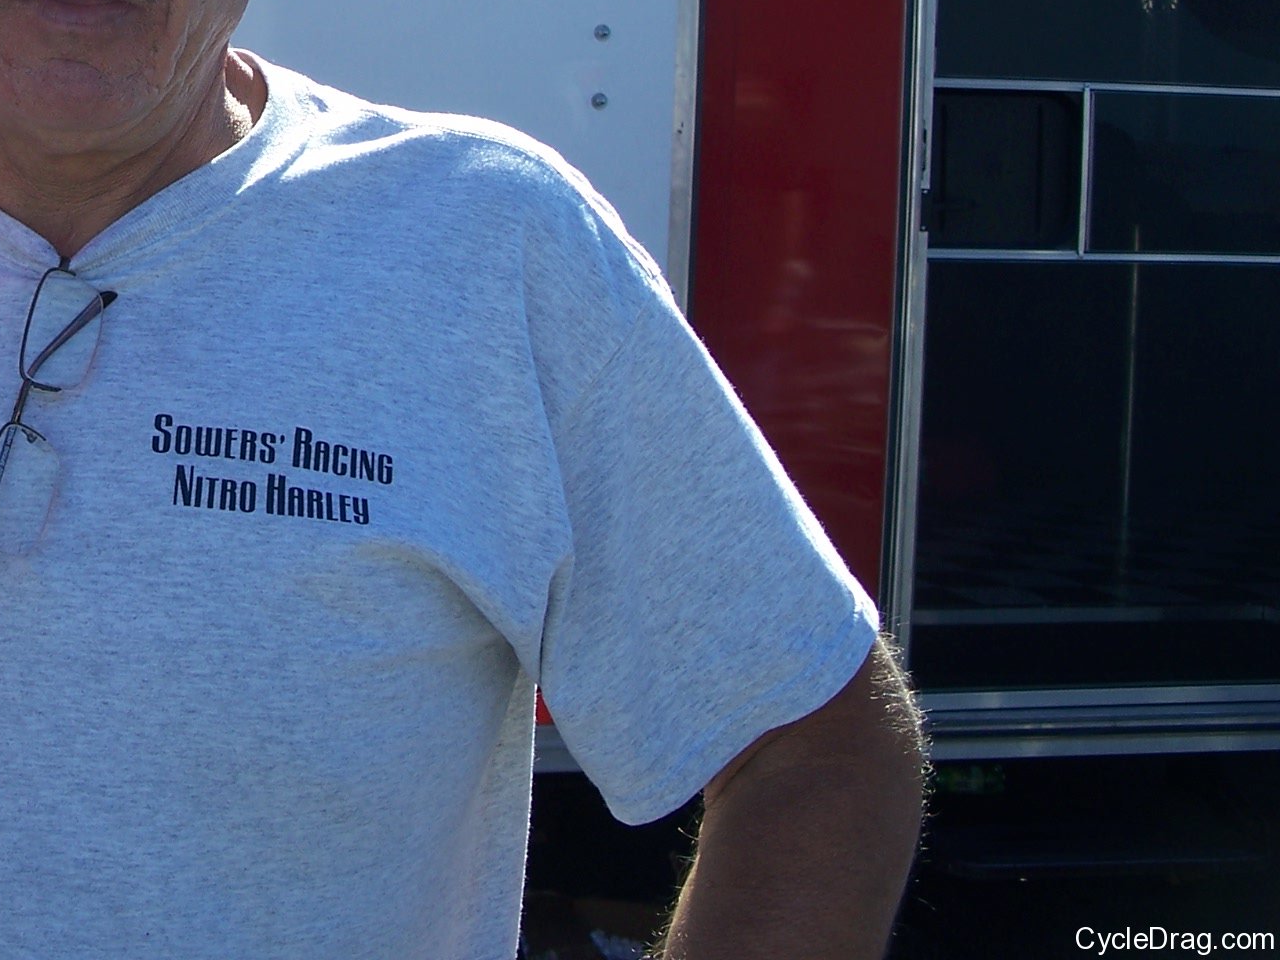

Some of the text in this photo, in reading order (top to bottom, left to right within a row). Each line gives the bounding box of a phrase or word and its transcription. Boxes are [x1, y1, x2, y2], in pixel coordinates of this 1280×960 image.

[292, 426, 394, 485] RACING
[173, 464, 370, 525] NITRO HARLEY
